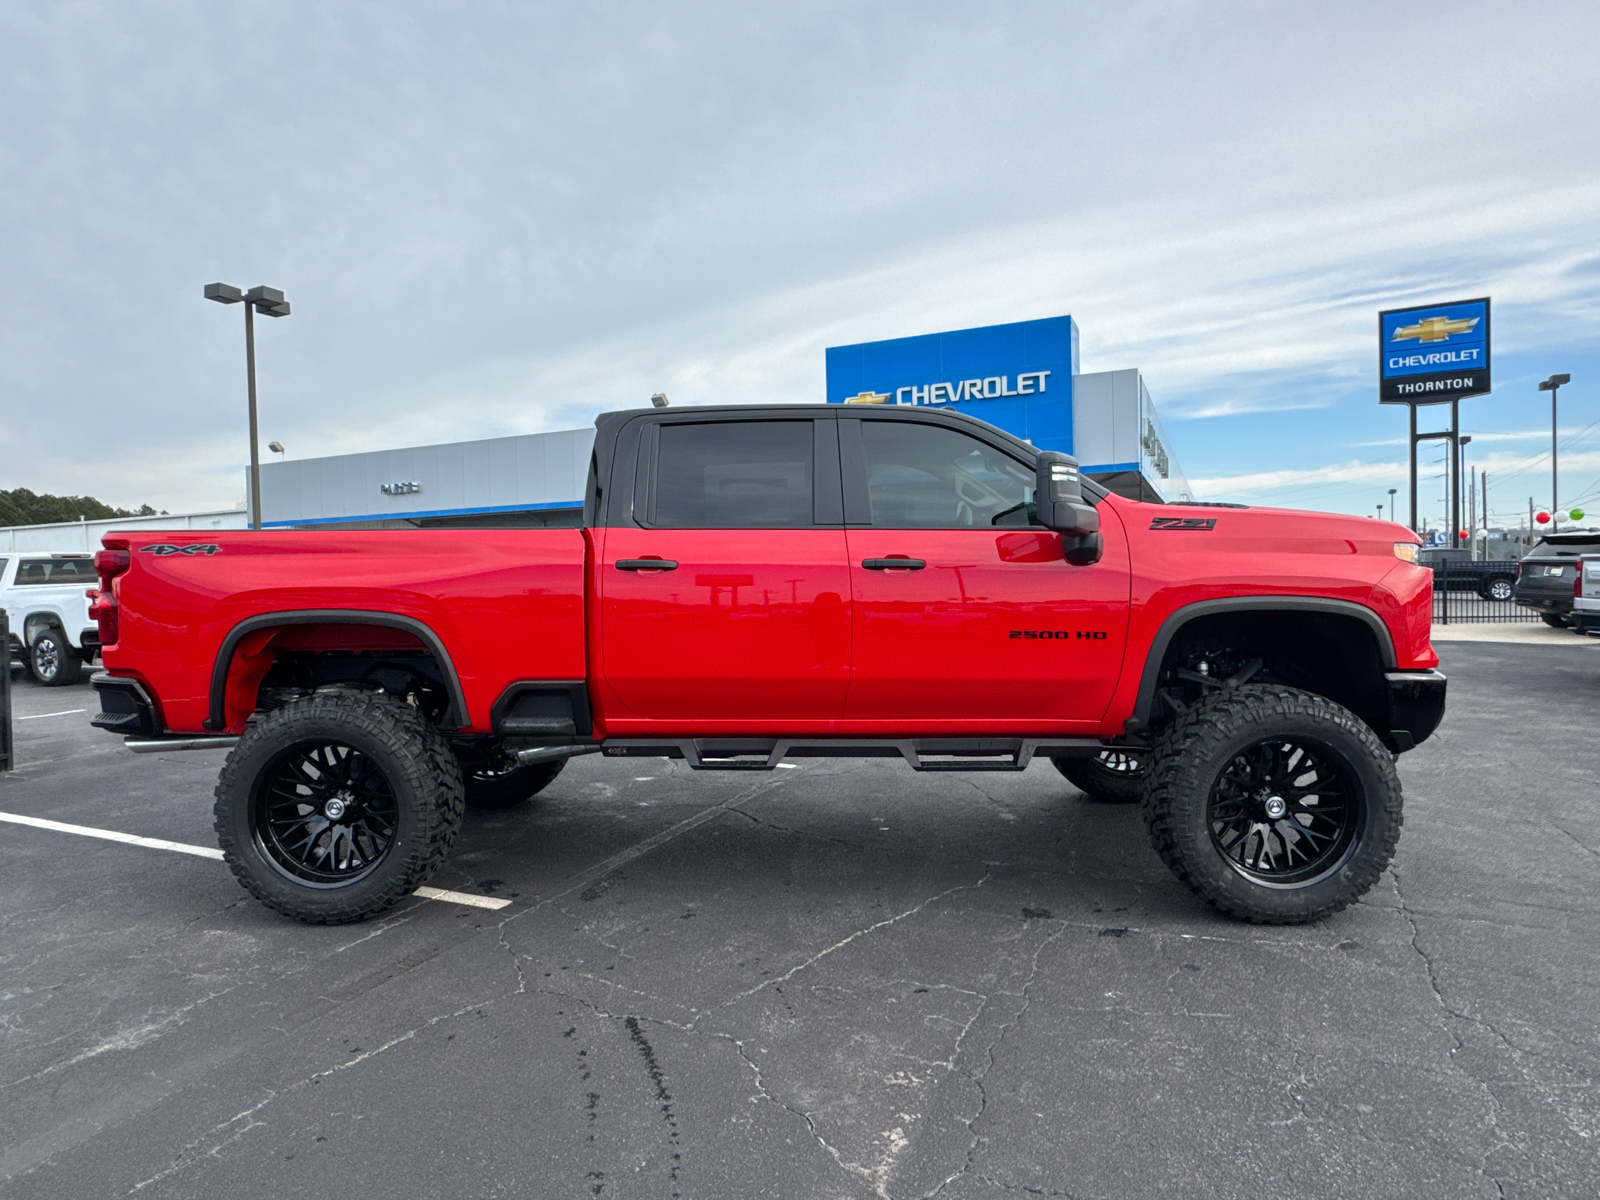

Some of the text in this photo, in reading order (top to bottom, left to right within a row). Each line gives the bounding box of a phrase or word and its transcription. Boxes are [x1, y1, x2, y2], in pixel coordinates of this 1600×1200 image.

[1389, 348, 1480, 369] CHEVROLET
[896, 370, 1051, 406] CHEVROLET
[1397, 378, 1473, 394] THORNTON
[1149, 517, 1217, 531] Z71
[1009, 630, 1107, 640] 2500 HD
